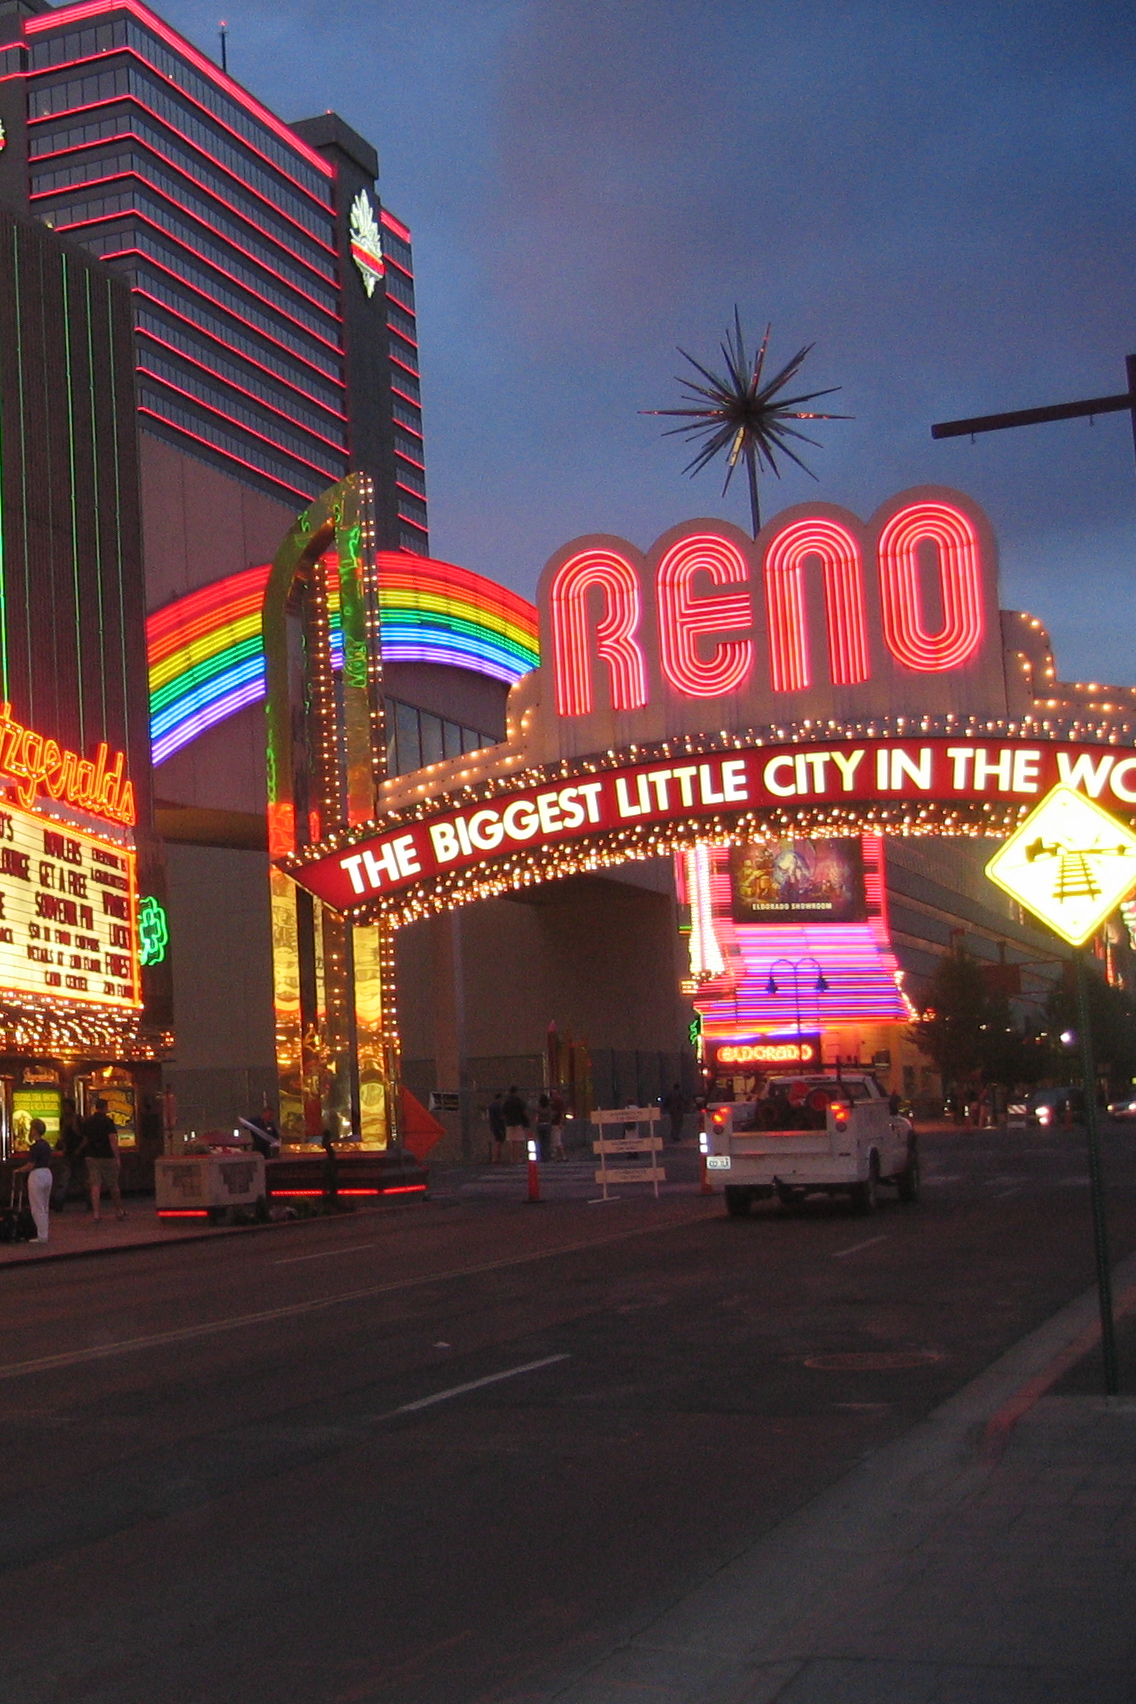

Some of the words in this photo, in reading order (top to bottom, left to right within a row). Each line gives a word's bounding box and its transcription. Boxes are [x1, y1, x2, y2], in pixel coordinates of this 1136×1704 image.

[550, 500, 983, 717] RENO
[339, 834, 422, 895] THE
[429, 782, 602, 864] BIGGEST
[615, 759, 749, 819] LITTLE
[763, 749, 865, 797] CITY
[876, 748, 931, 790] IN
[947, 747, 1040, 793] THE
[752, 903, 789, 911] ELDORADO
[791, 902, 833, 910] SHOWROOM
[717, 1044, 813, 1063] ELDORADO
